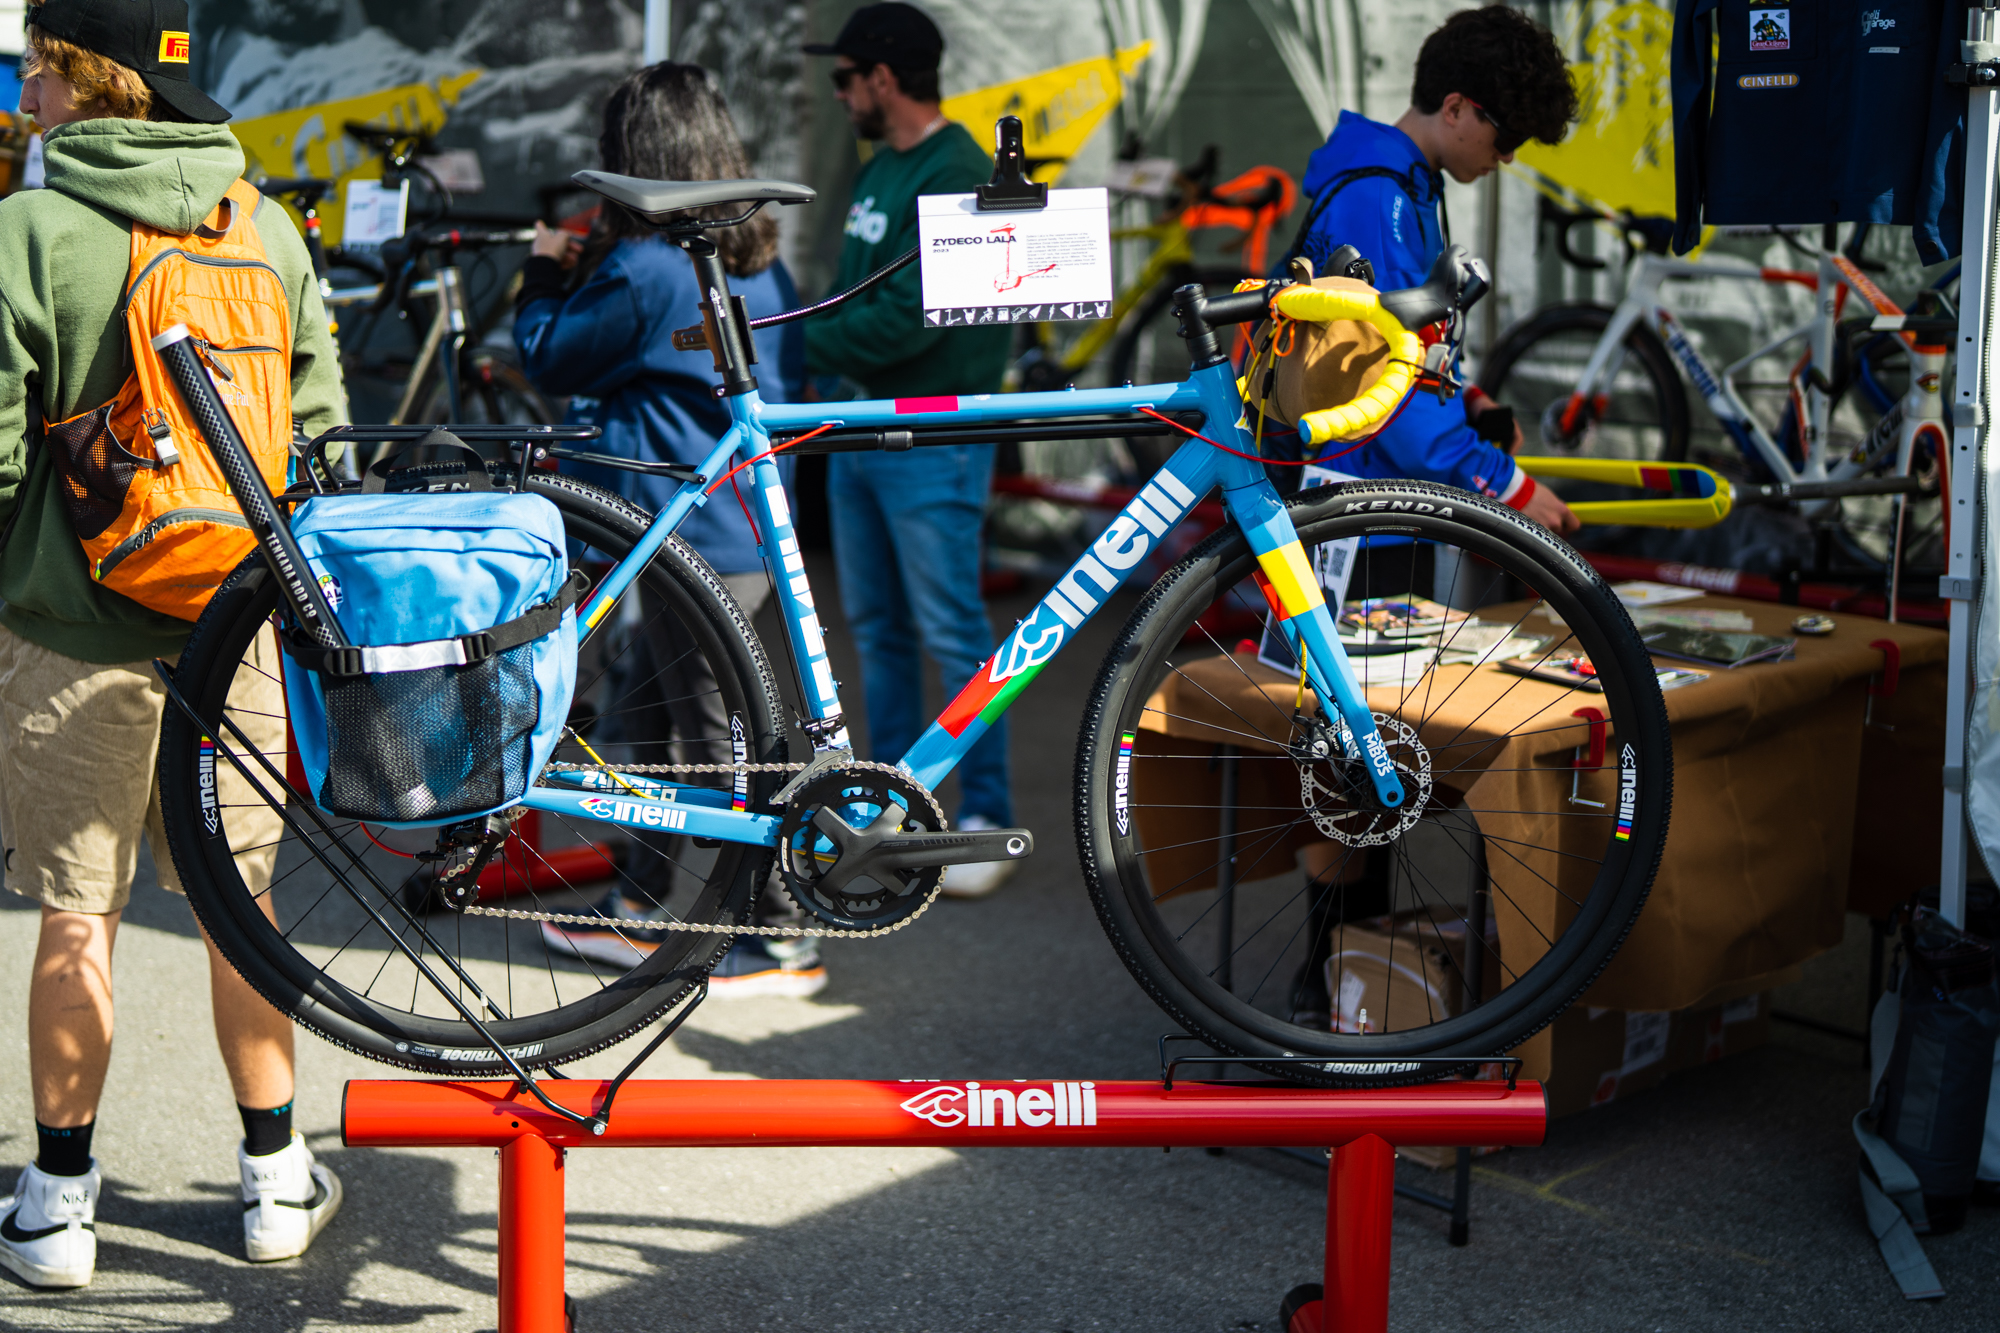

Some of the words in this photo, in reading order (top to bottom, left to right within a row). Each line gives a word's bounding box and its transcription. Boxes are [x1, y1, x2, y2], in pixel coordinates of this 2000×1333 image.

[1743, 75, 1793, 87] CINELLI
[933, 236, 983, 247] ZYDECO
[986, 235, 1017, 244] LALA
[1344, 500, 1453, 518] KENDA
[266, 532, 296, 580] TENKARA
[290, 580, 308, 602] ROD
[989, 468, 1196, 682] Cinelli
[1362, 732, 1390, 777] MBUS
[199, 756, 218, 834] Cinelli
[1115, 756, 1130, 835] Cinelli
[1619, 743, 1636, 820] Cinelli
[578, 798, 687, 830] Cinelli
[1323, 1062, 1407, 1075] FLINTRIDGE
[900, 1081, 1097, 1127] Cinelli
[251, 1169, 278, 1182] NIKE
[62, 1190, 89, 1204] NIKE
